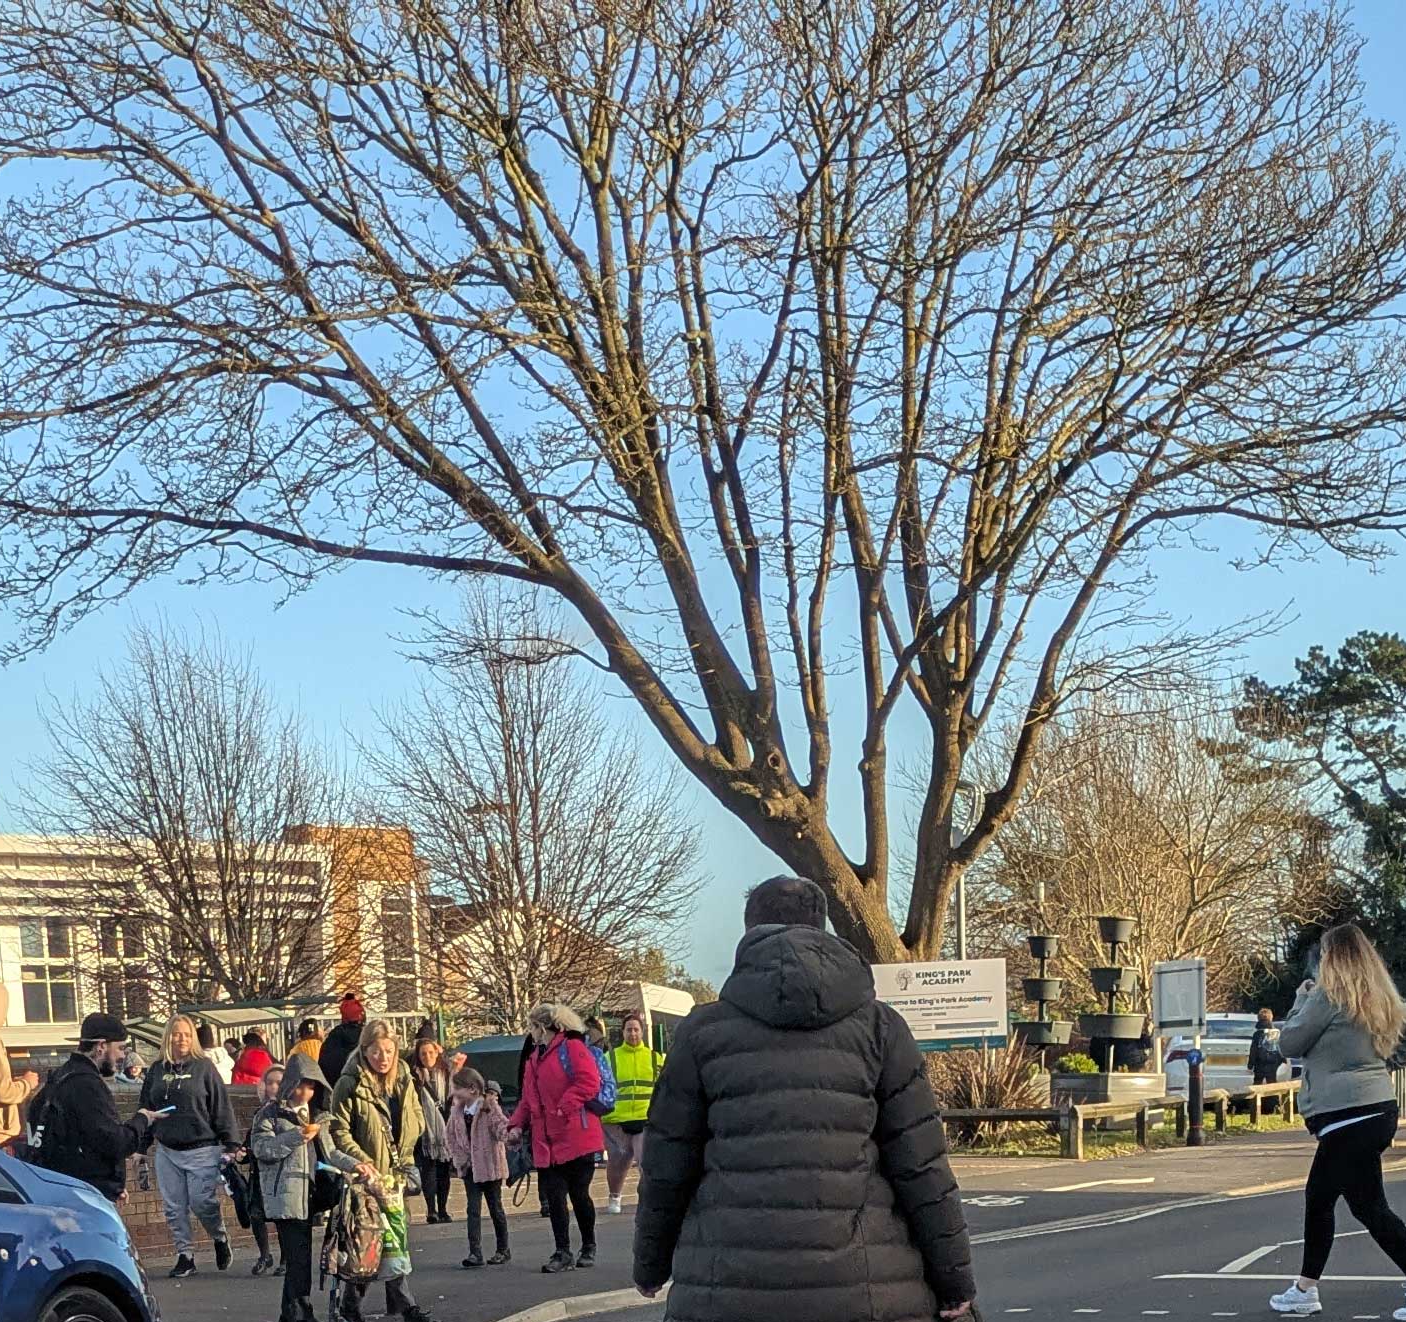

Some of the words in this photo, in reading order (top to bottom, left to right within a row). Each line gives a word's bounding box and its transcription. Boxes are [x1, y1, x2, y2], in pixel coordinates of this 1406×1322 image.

[915, 970, 945, 979] KING'S
[948, 969, 972, 977] PARK
[921, 977, 965, 986] ACADEMY
